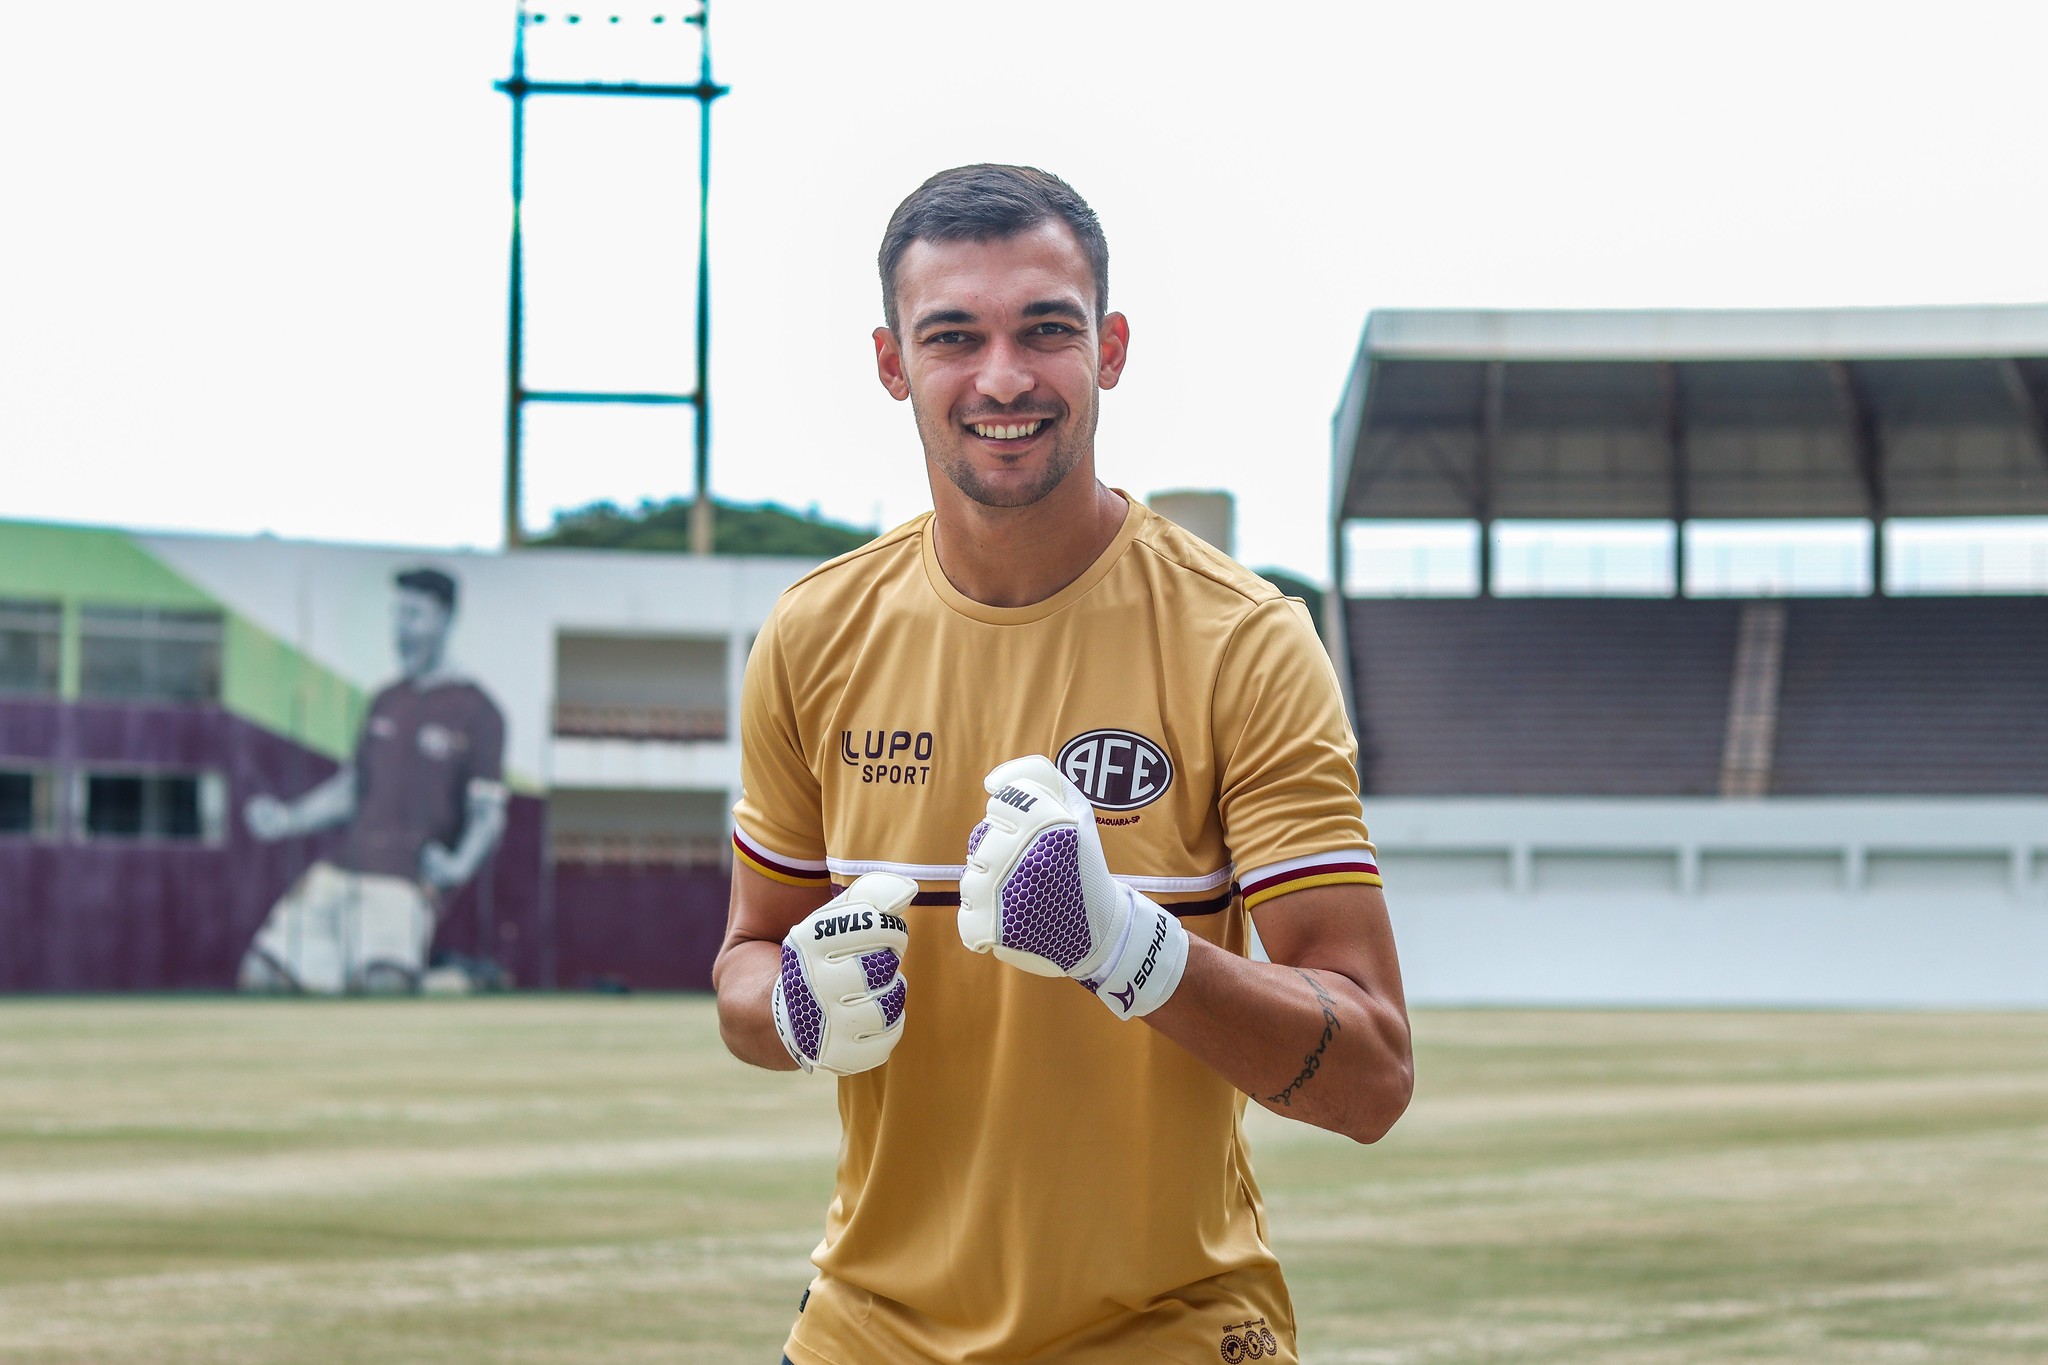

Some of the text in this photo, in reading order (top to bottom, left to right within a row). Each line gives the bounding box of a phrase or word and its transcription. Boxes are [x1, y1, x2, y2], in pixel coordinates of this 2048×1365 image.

[842, 731, 933, 766] LUPO
[862, 764, 930, 785] SPORT
[1065, 738, 1159, 800] AFE
[993, 785, 1039, 813] THRE
[1095, 815, 1141, 827] RAQUARA-SP
[814, 911, 873, 940] STARS
[1133, 913, 1168, 990] SOPHIA
